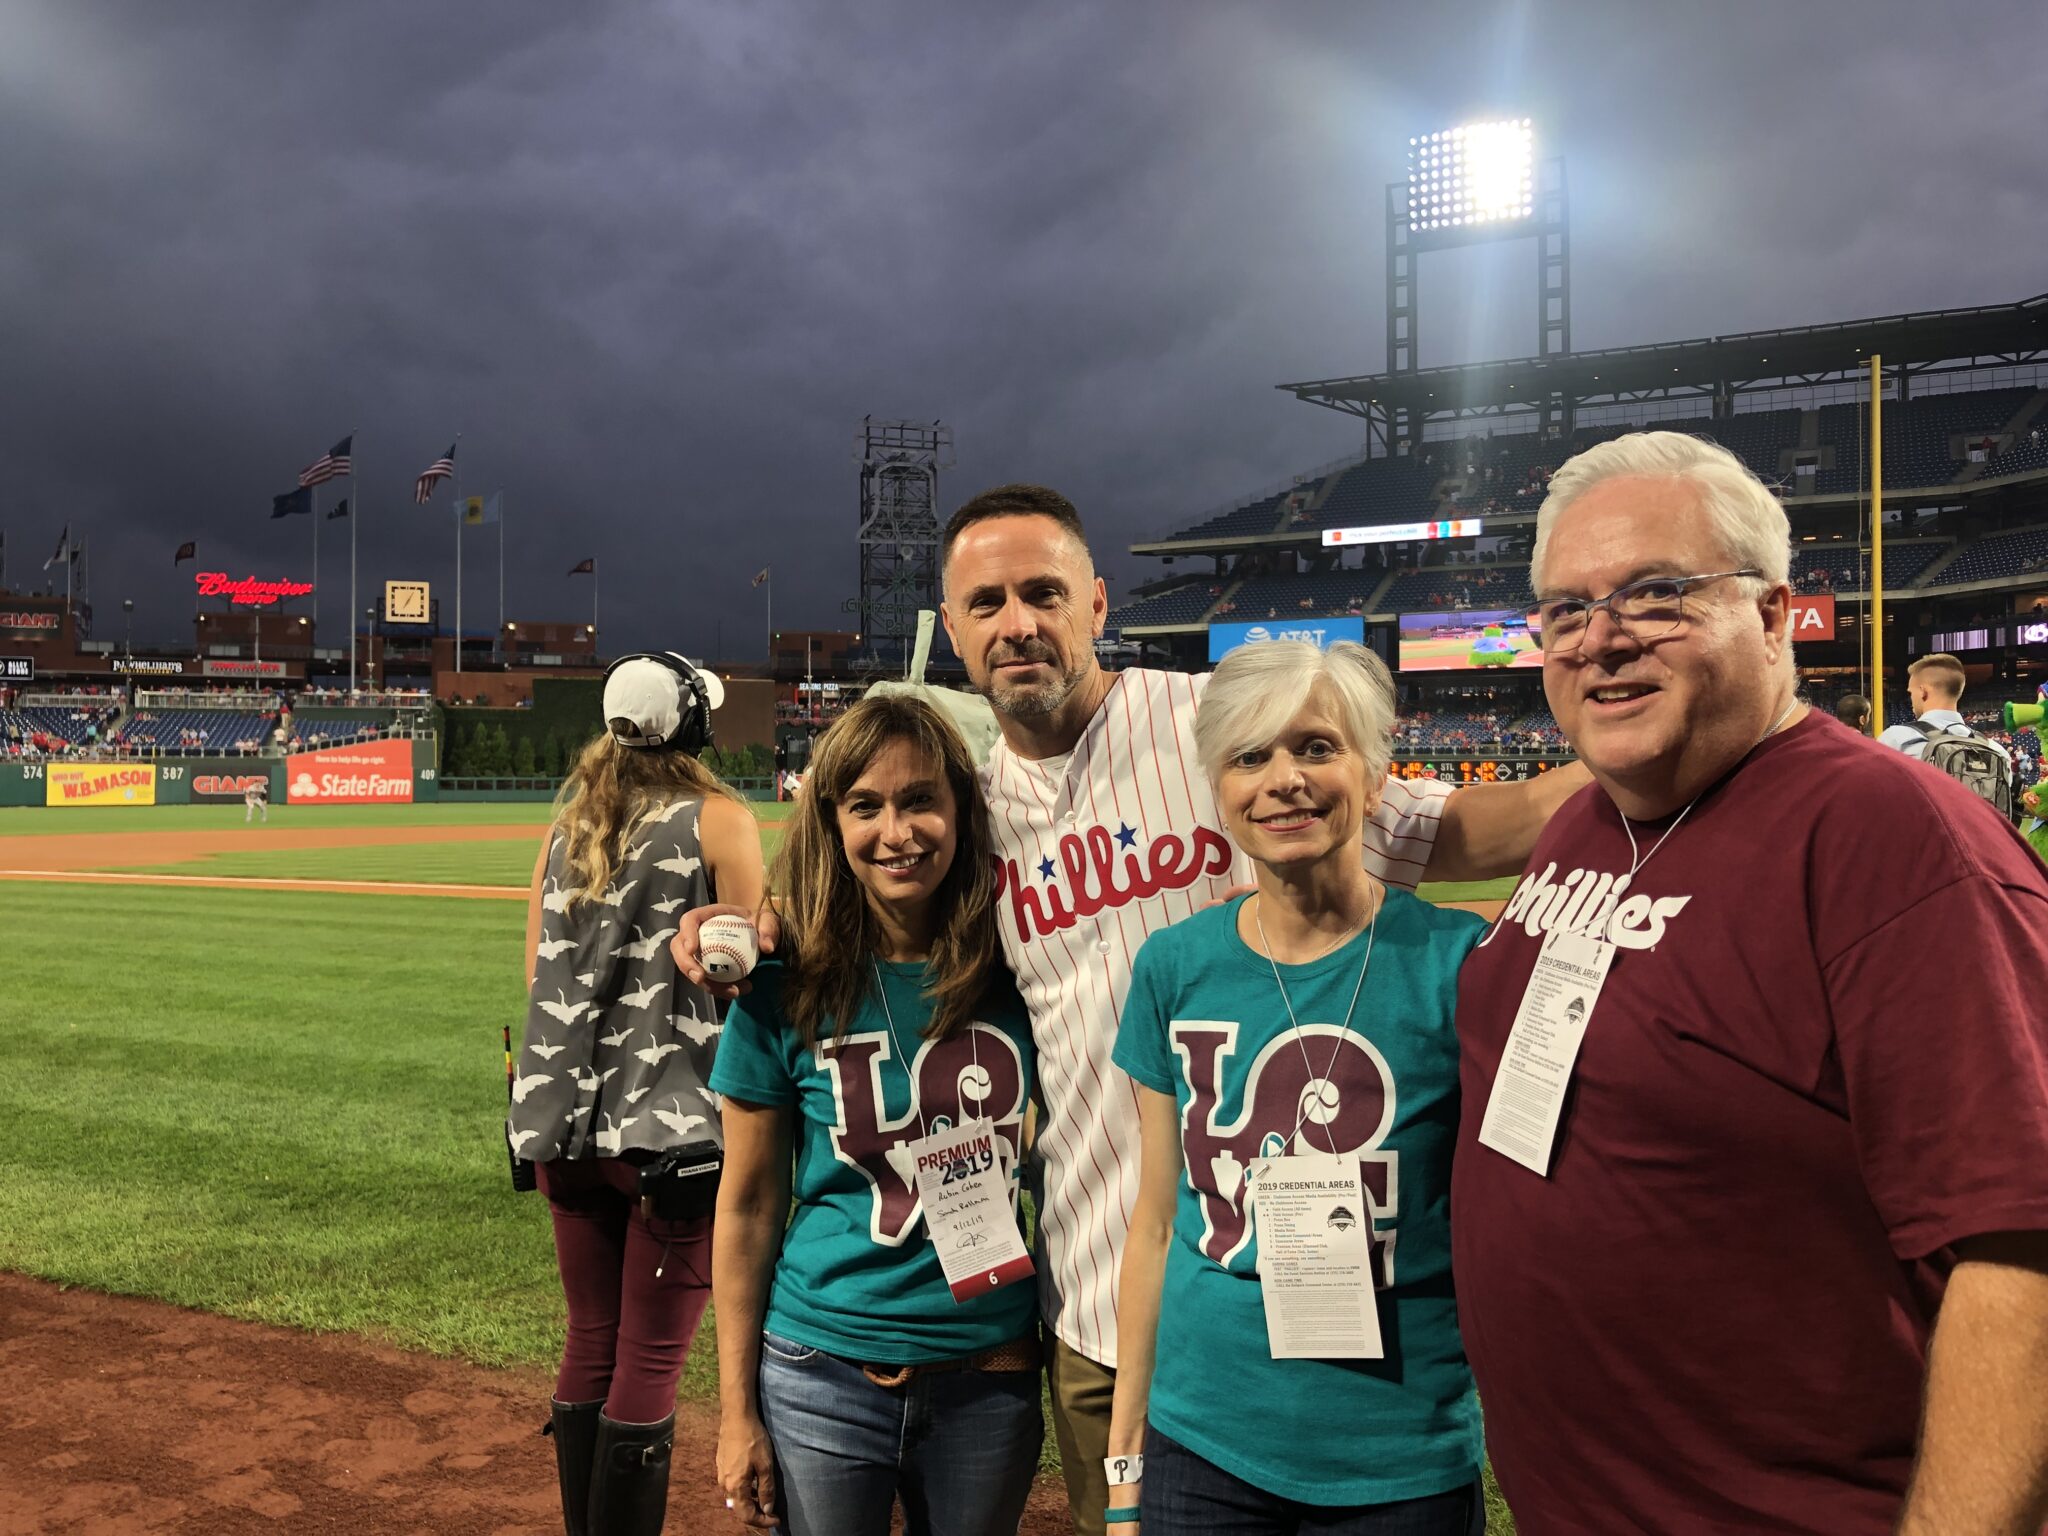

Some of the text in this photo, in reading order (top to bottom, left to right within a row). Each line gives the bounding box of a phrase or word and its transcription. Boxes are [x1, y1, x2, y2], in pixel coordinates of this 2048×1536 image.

[196, 572, 313, 595] Budweiser
[1277, 629, 1327, 650] AT&T
[799, 683, 821, 691] SEAONS
[23, 765, 43, 780] 374
[162, 767, 183, 780] 387
[1440, 762, 1455, 771] STL
[1516, 762, 1528, 771] PIT
[420, 769, 435, 781] 409
[1440, 773, 1456, 781] COL
[1552, 959, 1583, 976] CREDENTIAL
[1582, 968, 1602, 981] AREAS
[917, 1135, 992, 1173] PREMIUM
[938, 1149, 994, 1186] 2019
[1257, 1180, 1355, 1191] 2019 CREDENTIAL AREAS
[988, 1271, 999, 1286] 6
[1113, 1458, 1129, 1483] P
